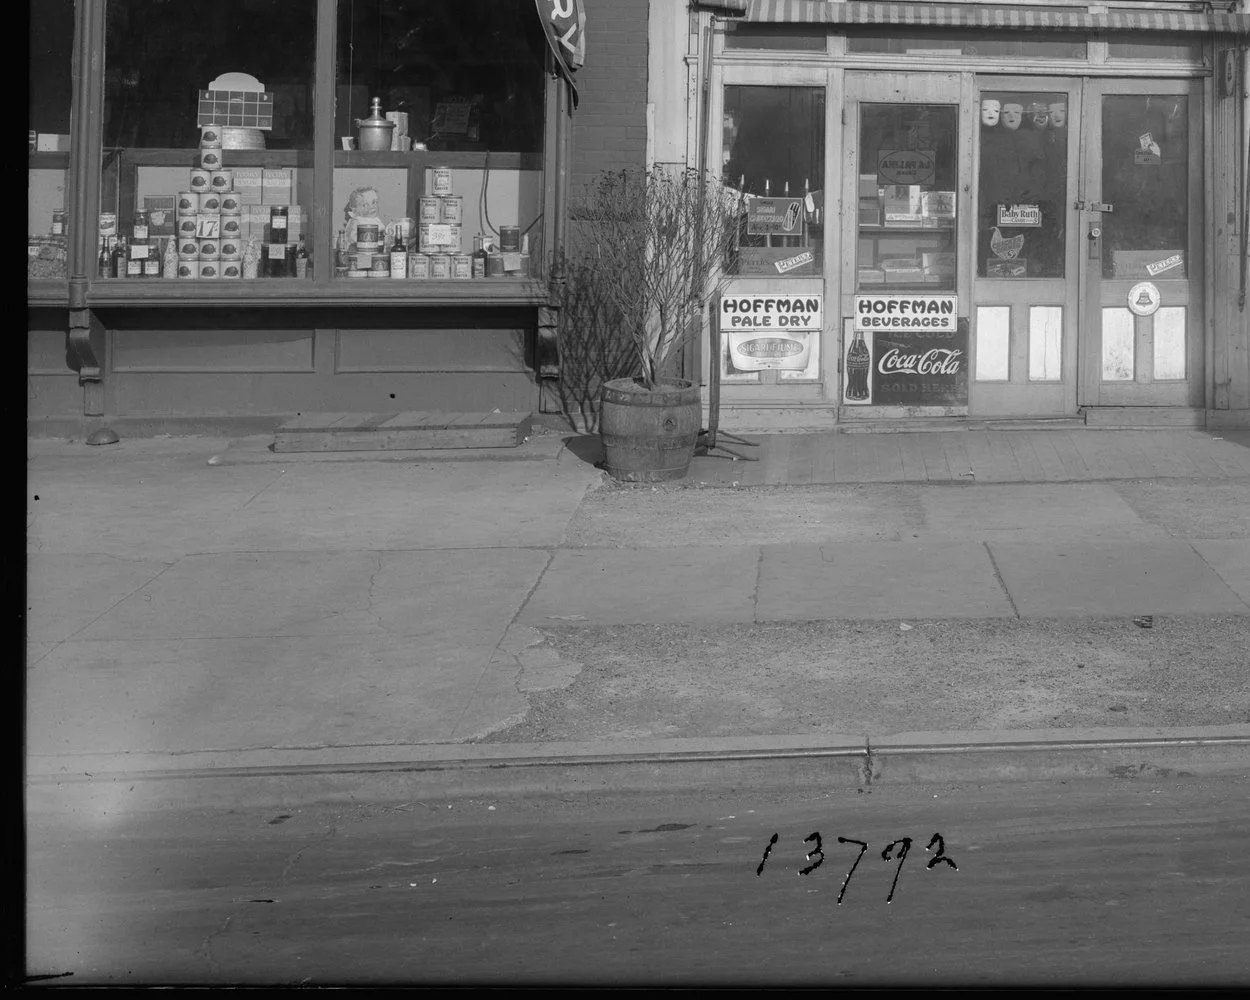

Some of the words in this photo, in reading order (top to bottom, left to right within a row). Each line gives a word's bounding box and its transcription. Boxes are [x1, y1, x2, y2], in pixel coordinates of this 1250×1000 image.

[1020, 209, 1038, 218] Ruth
[722, 298, 819, 313] HOFFMAN
[858, 299, 953, 314] HOFFMAN
[731, 316, 772, 327] PALE
[778, 316, 811, 328] DRY
[861, 317, 949, 328] BEVERAGES
[878, 348, 963, 375] Coca-Cola
